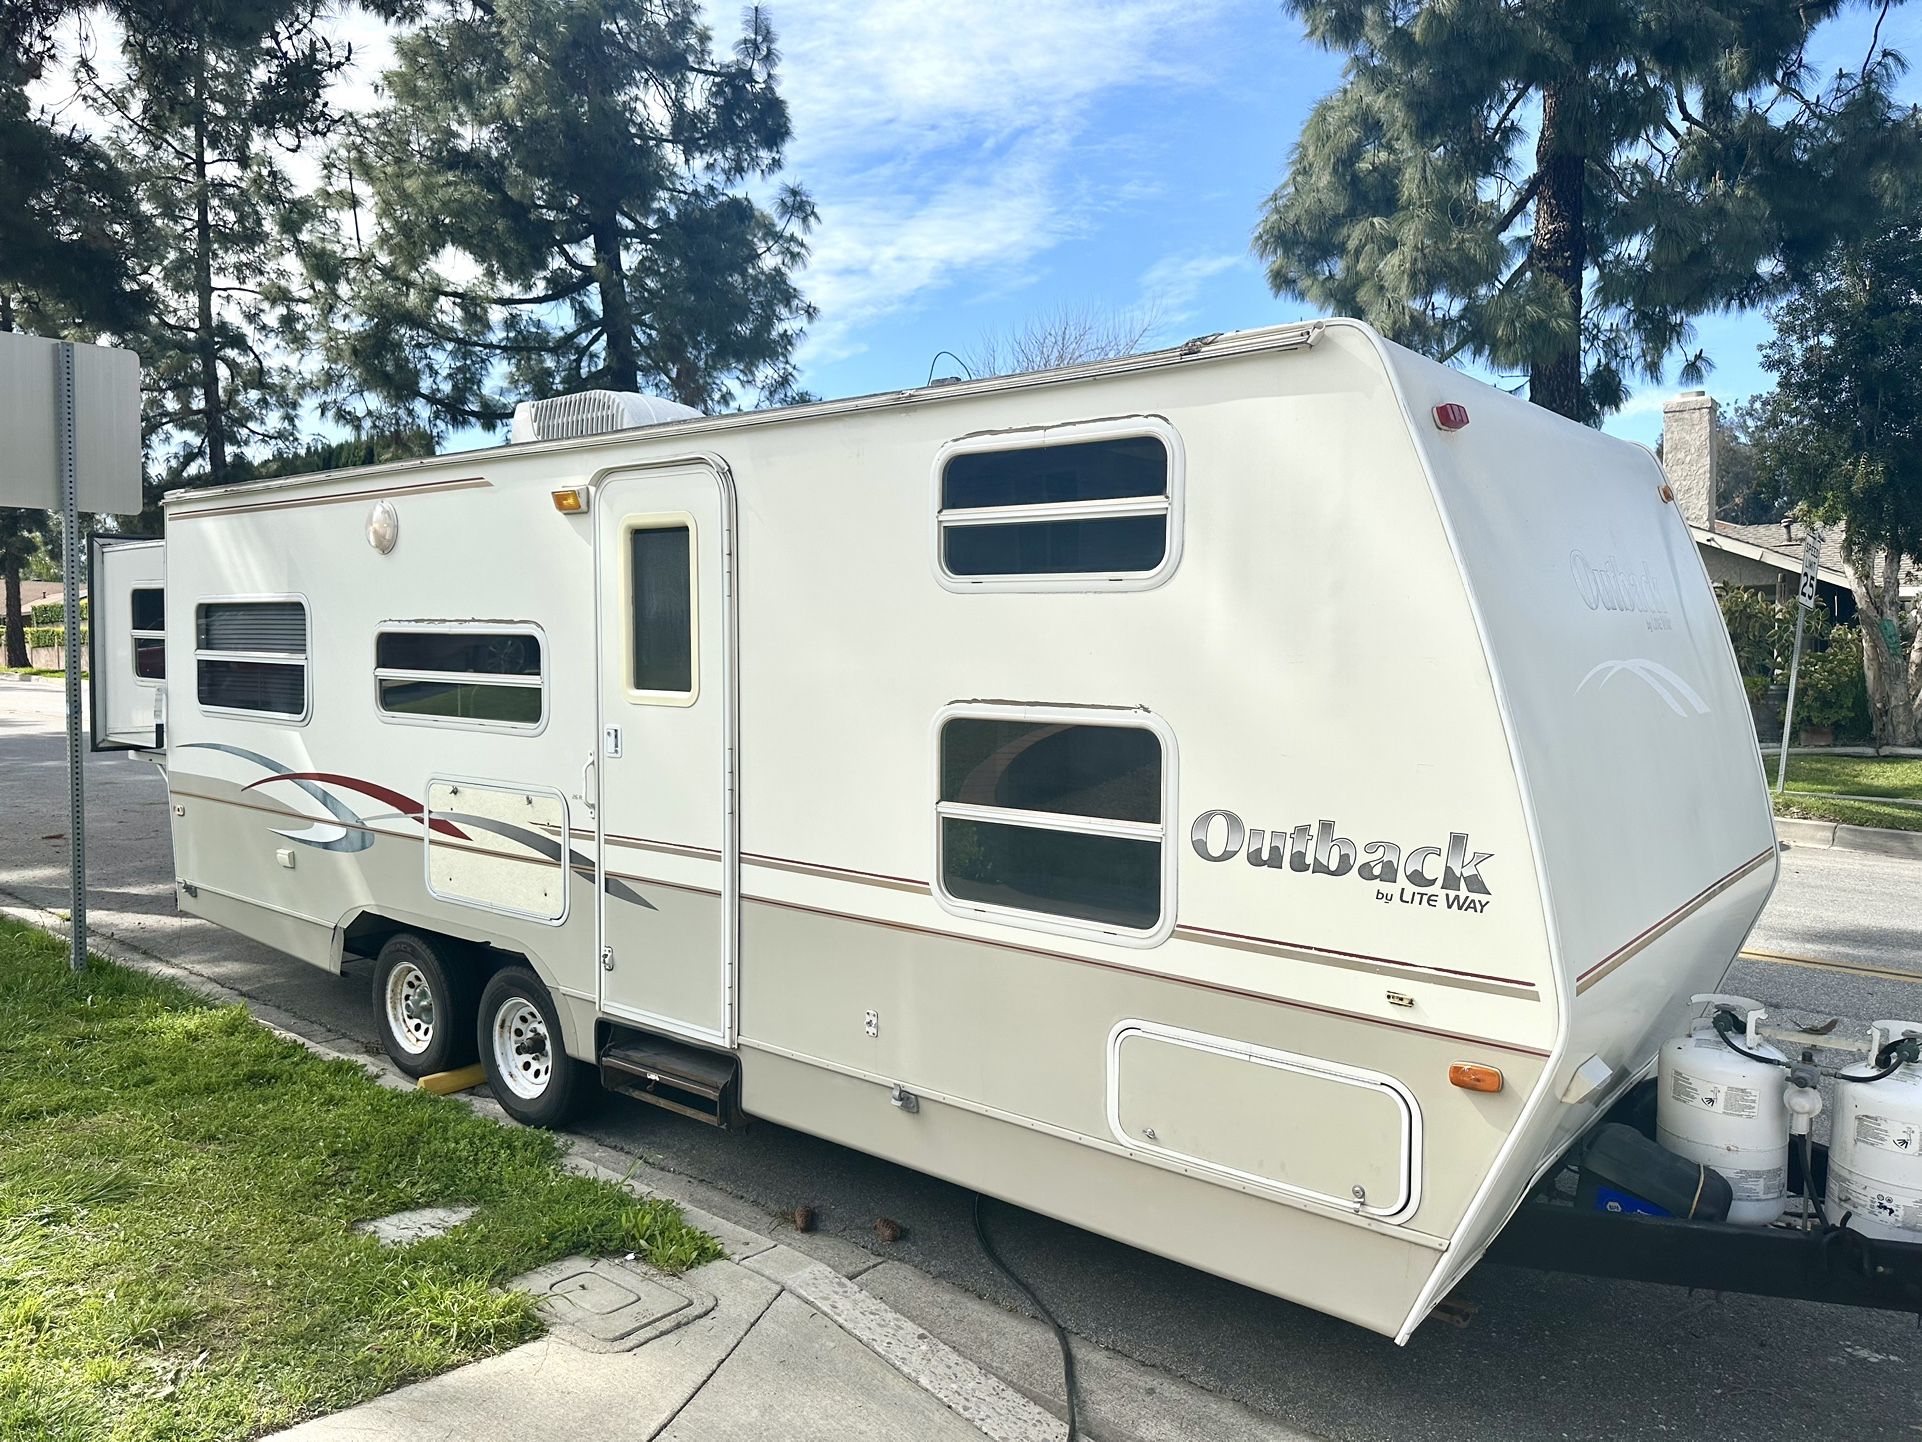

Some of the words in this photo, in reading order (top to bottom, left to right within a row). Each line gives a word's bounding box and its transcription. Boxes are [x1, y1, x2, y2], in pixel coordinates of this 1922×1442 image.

[1805, 542, 1819, 559] SPEED
[1800, 571, 1815, 601] 25
[1190, 809, 1496, 896] Outback
[1375, 889, 1394, 904] by
[1399, 887, 1438, 908] LITE
[1445, 893, 1490, 914] WAY
